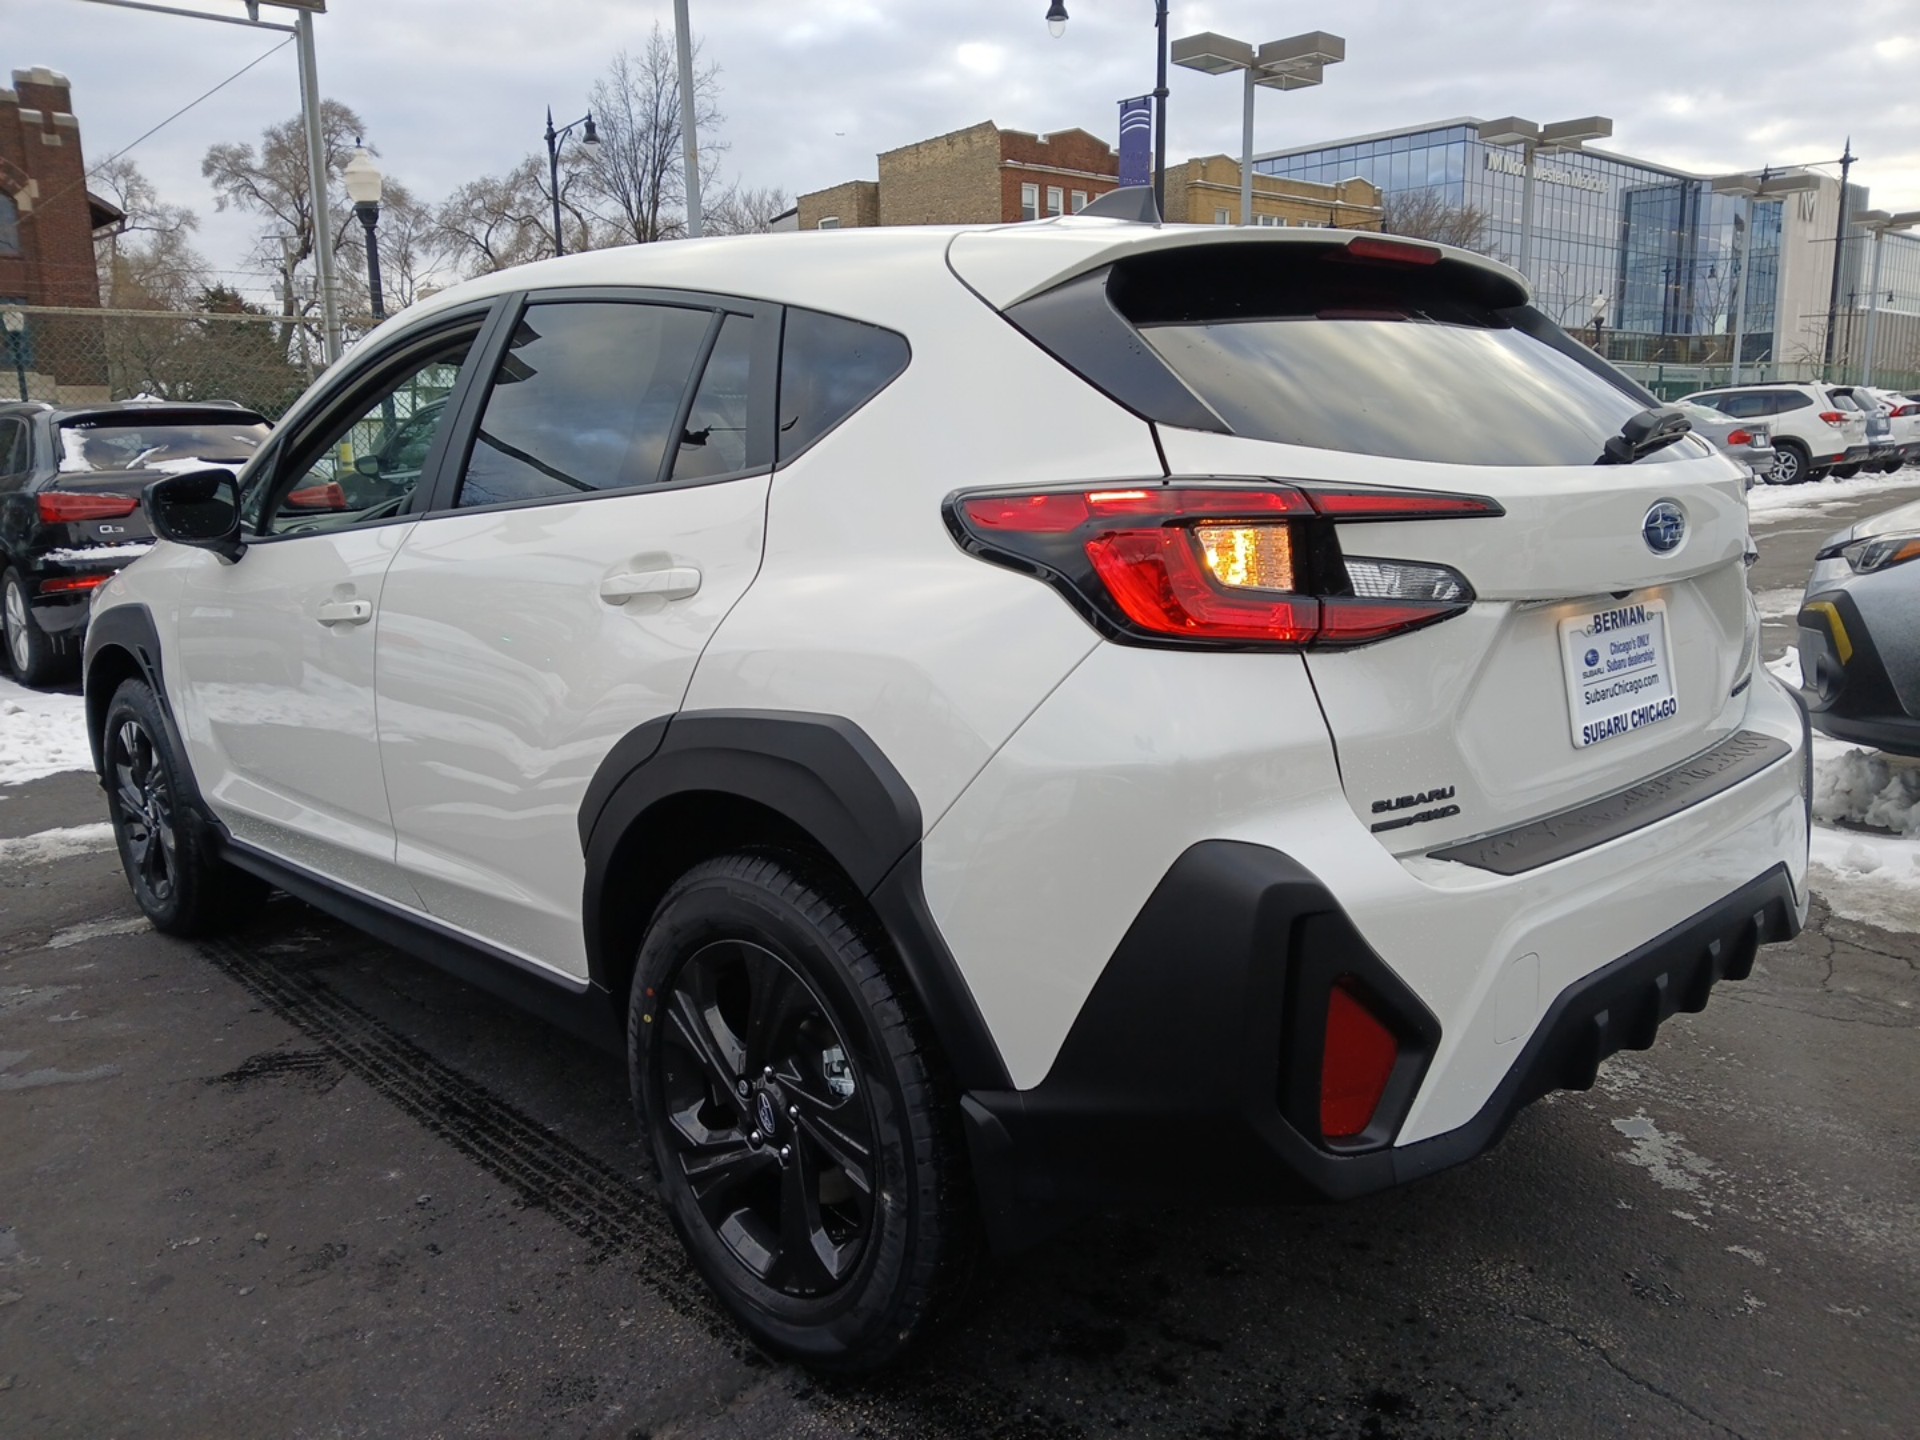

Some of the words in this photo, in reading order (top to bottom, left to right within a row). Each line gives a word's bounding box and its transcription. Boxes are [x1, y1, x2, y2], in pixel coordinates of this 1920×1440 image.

[1594, 605, 1645, 634] BERMAN
[1610, 637, 1636, 655] Chicago's
[1637, 633, 1649, 647] ONLY
[1606, 656, 1627, 673] Subaru
[1585, 673, 1659, 705] SubaruChicago.com
[1583, 713, 1628, 744] SUBARU
[1631, 698, 1677, 727] CHICAGO
[1371, 785, 1455, 814] SUBARU
